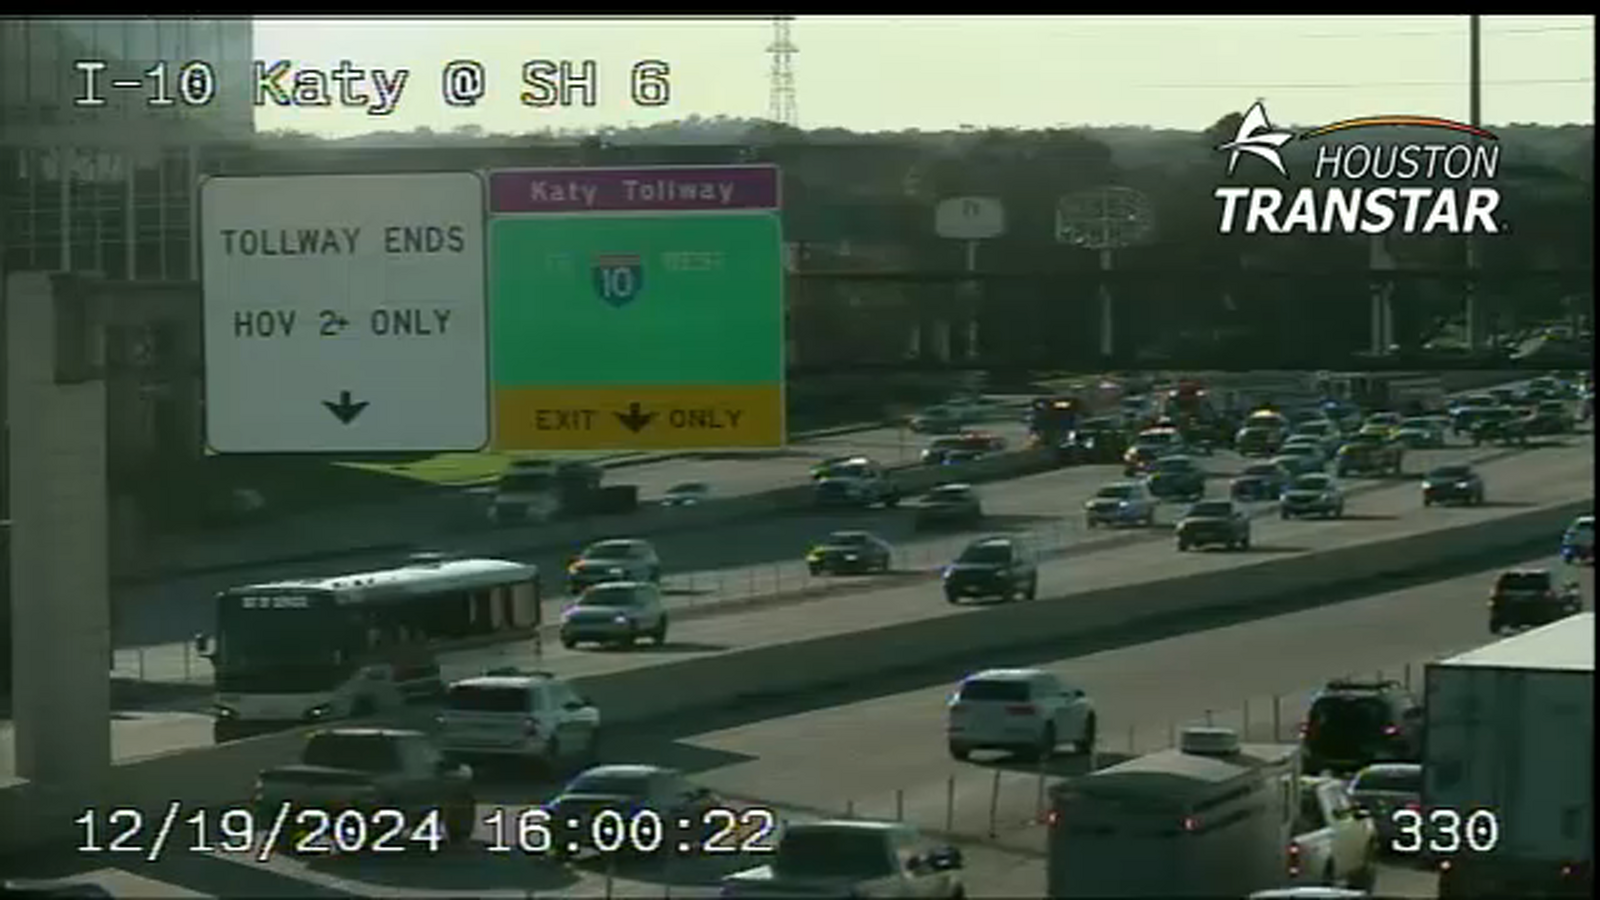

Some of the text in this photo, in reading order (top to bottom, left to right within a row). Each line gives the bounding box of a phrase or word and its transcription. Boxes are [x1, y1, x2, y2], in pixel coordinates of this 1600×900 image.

[531, 178, 735, 205] Katy Tollway
[220, 226, 465, 256] TOLLWAY ENDS
[602, 266, 635, 298] 10
[233, 309, 298, 338] HOV
[371, 309, 452, 336] ONLY
[535, 406, 742, 432] EXIT ONLY
